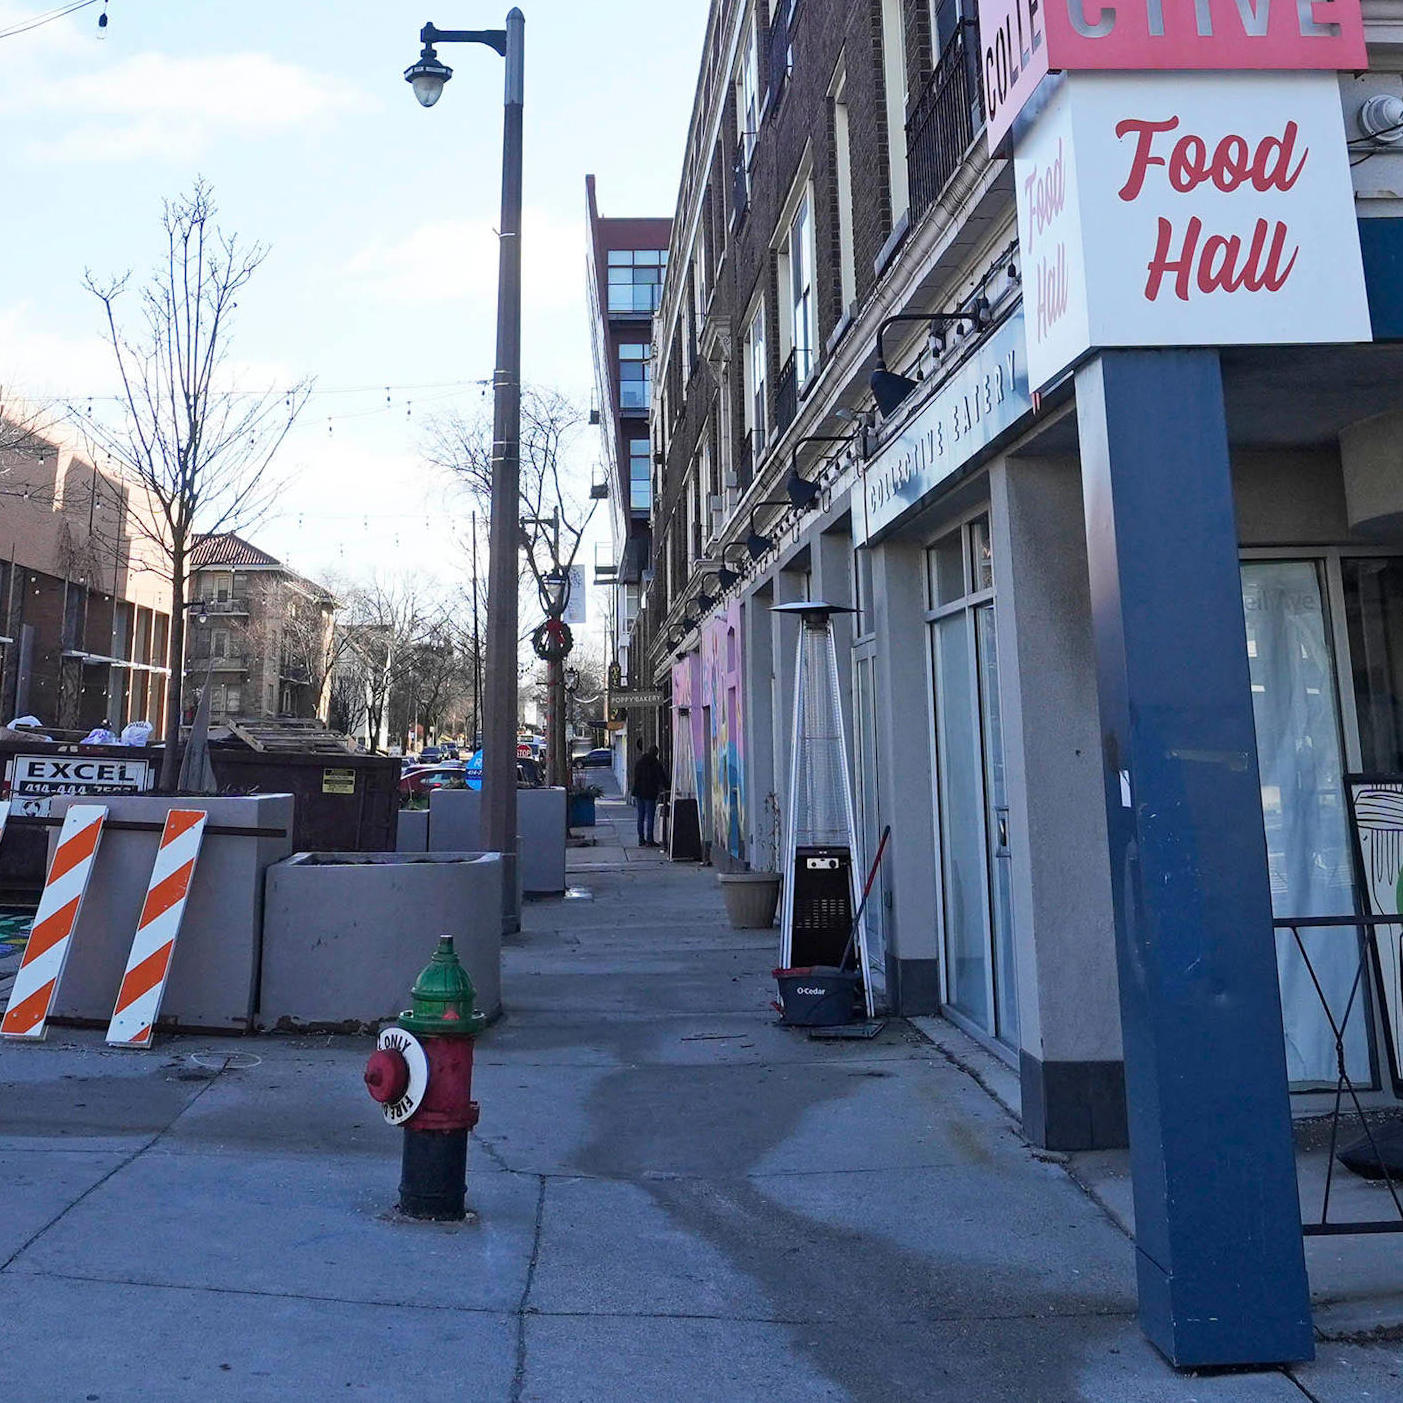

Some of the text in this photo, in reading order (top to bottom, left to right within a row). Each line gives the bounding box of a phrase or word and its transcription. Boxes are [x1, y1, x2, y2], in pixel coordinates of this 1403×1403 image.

[1024, 136, 1067, 255] Food
[1115, 115, 1309, 202] Food
[1035, 242, 1069, 343] Hall
[1144, 216, 1300, 302] Hall
[870, 349, 1016, 515] COLLECTIVE EATERY
[635, 695, 661, 703] BAKERY
[27, 761, 135, 782] EXCEL
[384, 1034, 412, 1053] ONLY
[390, 1094, 415, 1120] FIRE
